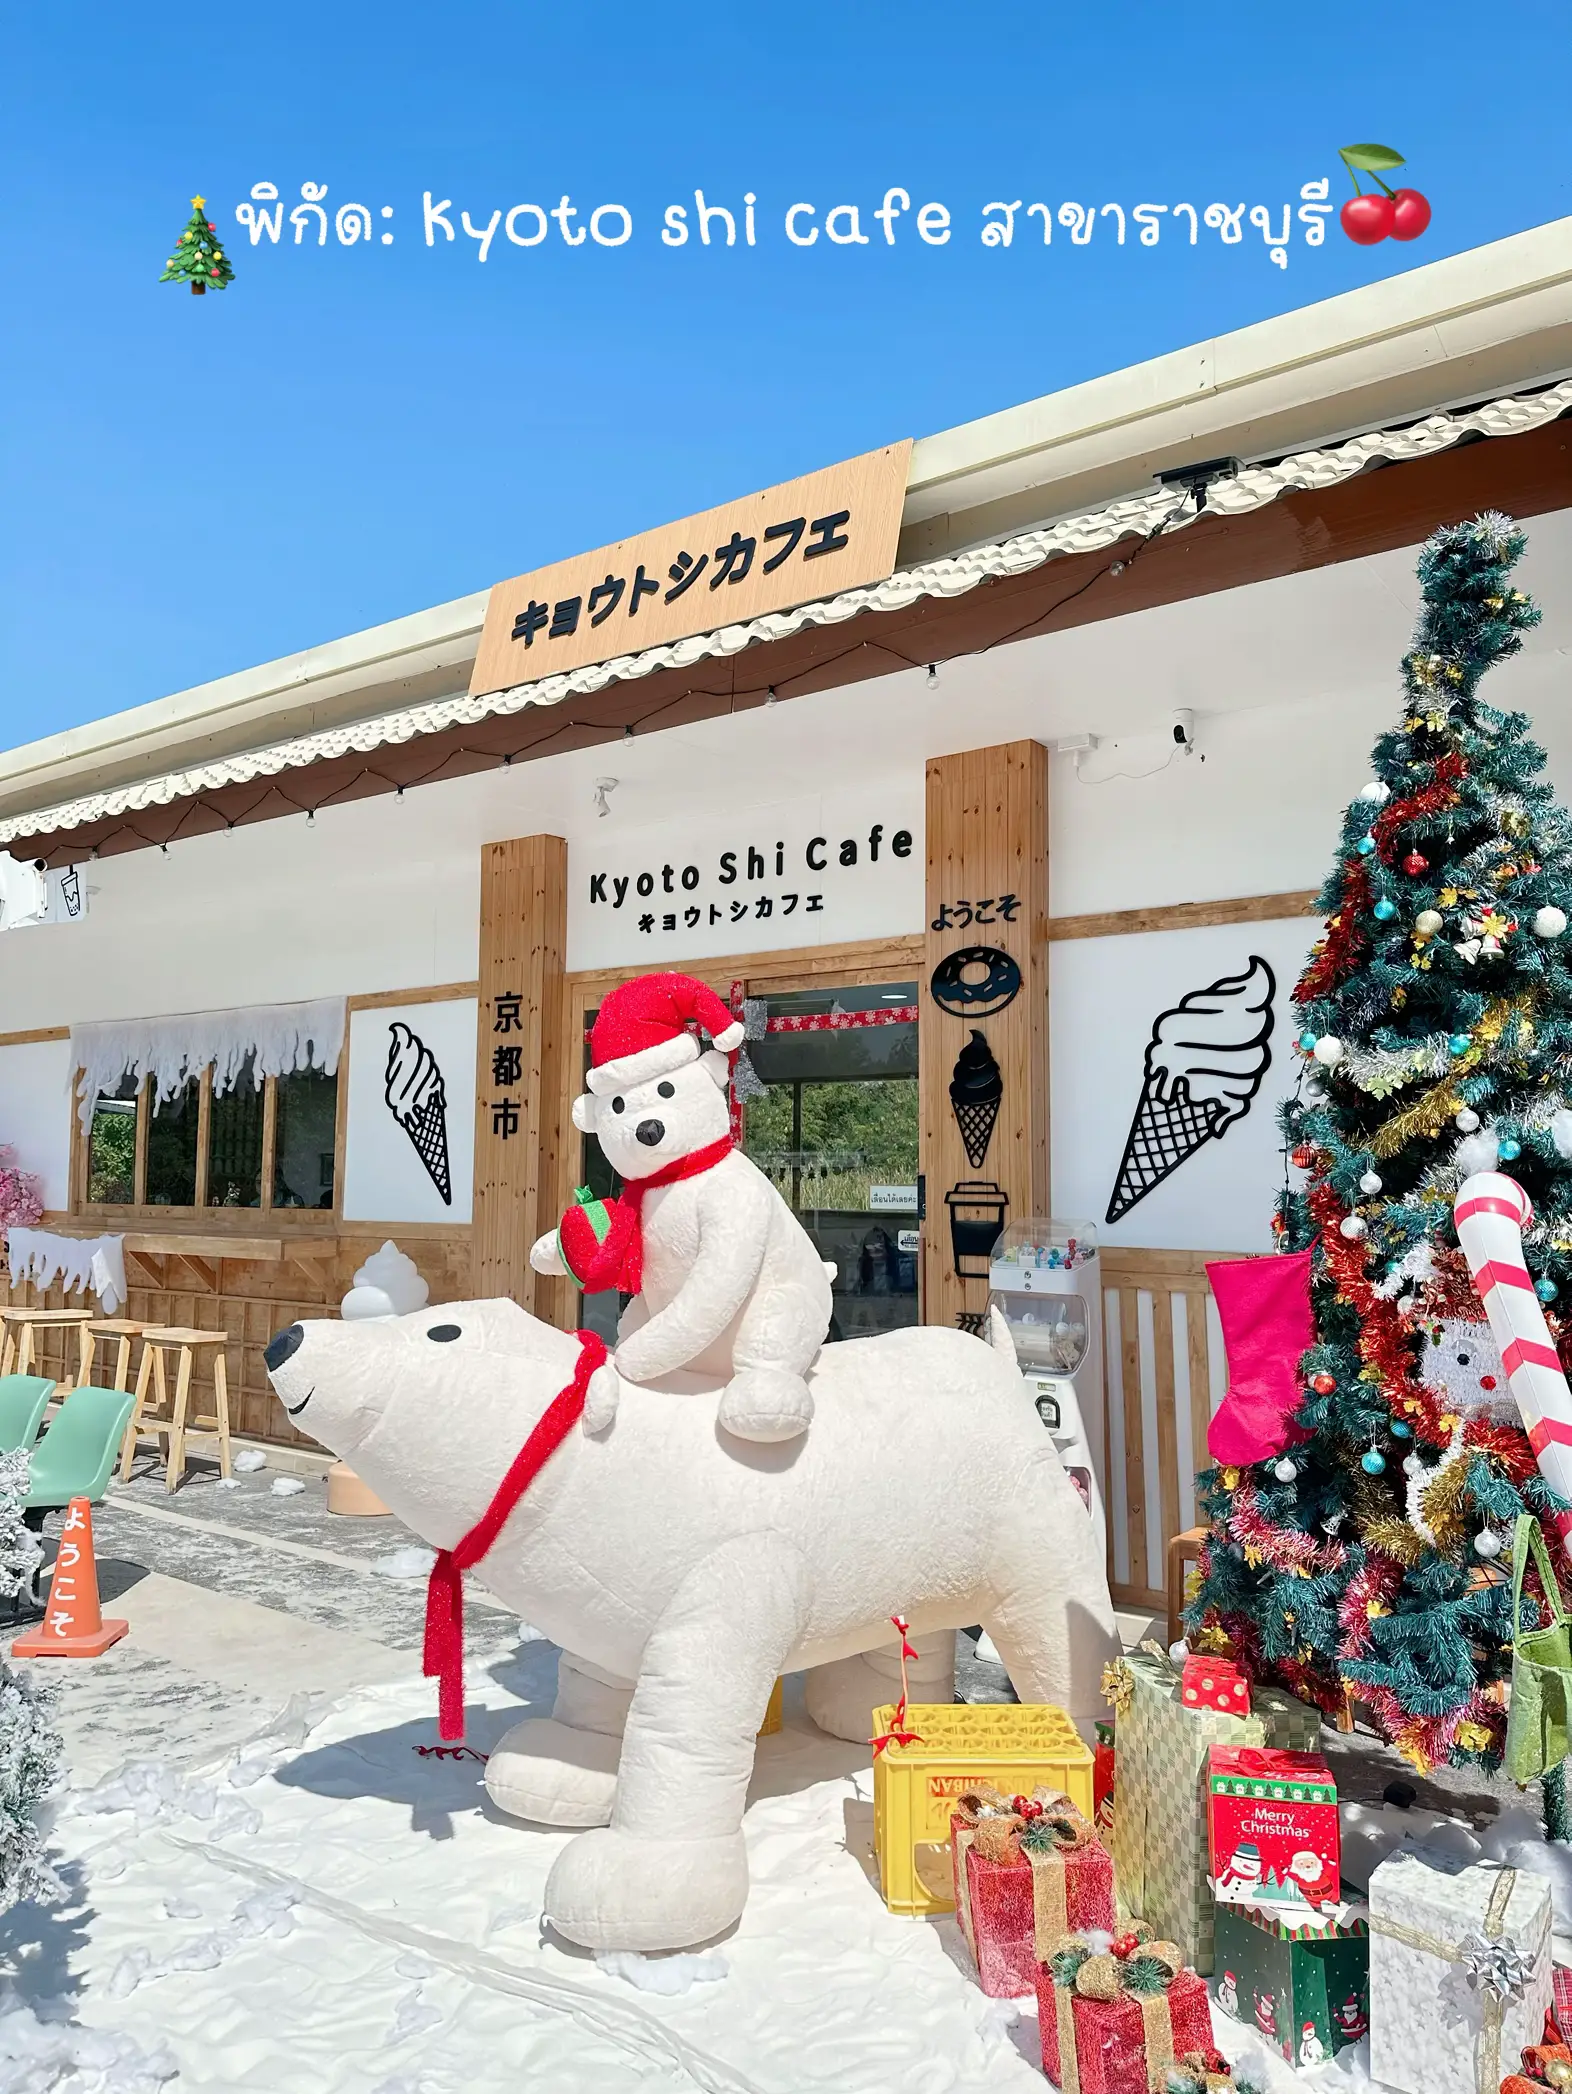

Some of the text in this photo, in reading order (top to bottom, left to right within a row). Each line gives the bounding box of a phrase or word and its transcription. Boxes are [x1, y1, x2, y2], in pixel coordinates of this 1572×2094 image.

[511, 509, 850, 648] キョウトシカフェ
[590, 824, 913, 908] Kyoto Shi Cafe
[636, 892, 824, 933] キョウトシカフェ
[931, 893, 1022, 932] ようこそ
[491, 991, 523, 1140] 京都市
[50, 1507, 86, 1637] ようこそ
[1240, 1819, 1310, 1838] Christmas
[1254, 1807, 1295, 1825] Merry
